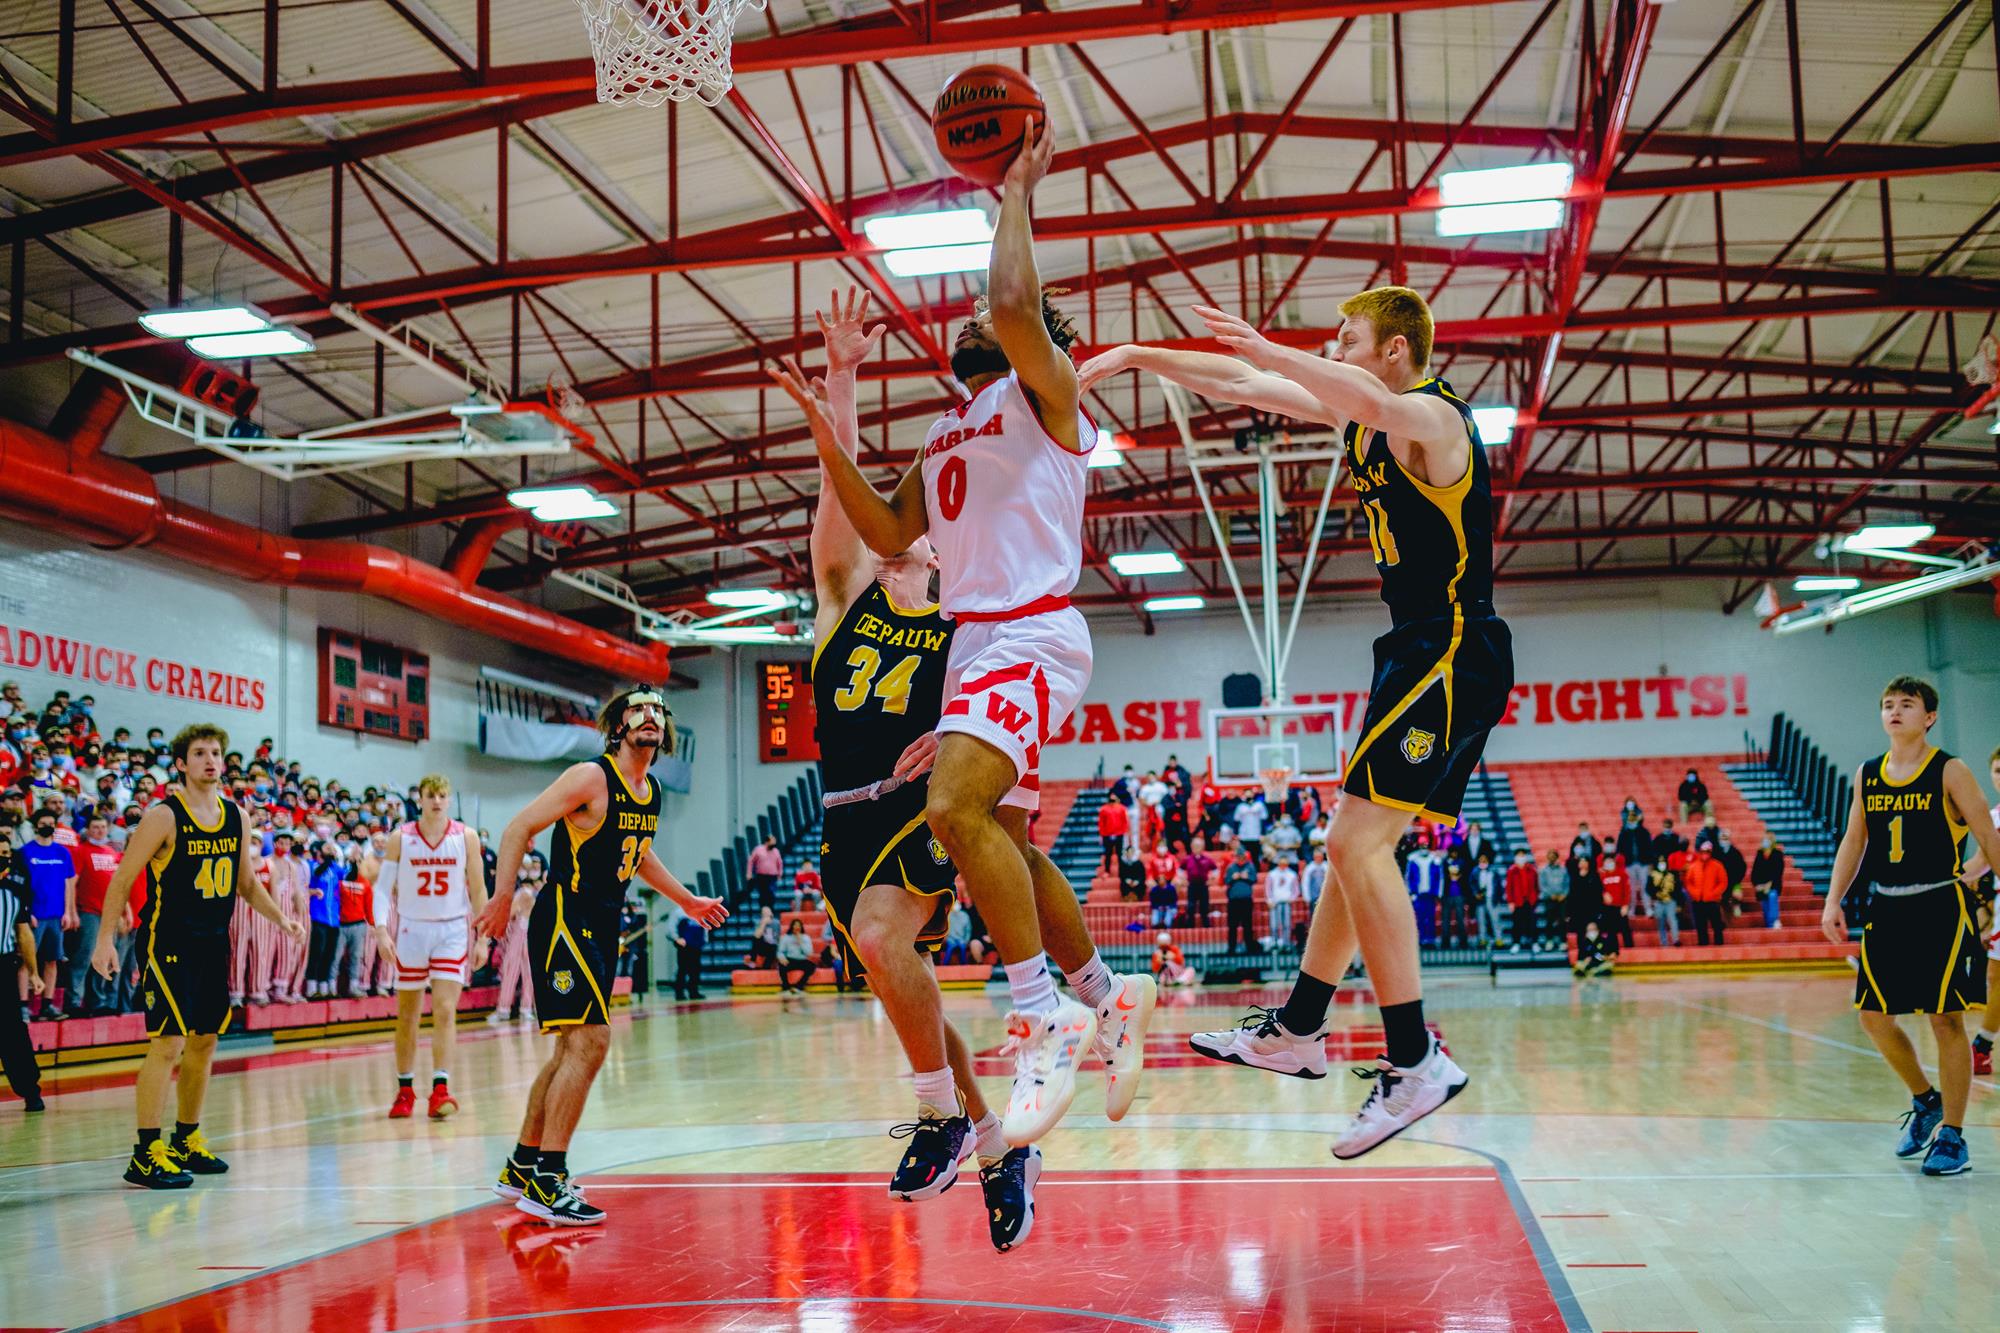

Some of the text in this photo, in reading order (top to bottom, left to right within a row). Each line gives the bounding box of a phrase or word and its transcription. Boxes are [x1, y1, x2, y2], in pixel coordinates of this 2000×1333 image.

[936, 84, 1007, 113] Wilson
[947, 117, 1001, 147] NCAA
[937, 455, 967, 521] 0
[0, 594, 26, 617] THE
[853, 613, 947, 651] DEPAUW
[145, 657, 265, 712] CRAZIES
[766, 675, 794, 700] 95
[834, 644, 922, 715] 34
[1498, 674, 1748, 726] FIGHTS!
[1866, 793, 1932, 812] DEPAUW
[187, 837, 238, 856] DEPAUW
[1888, 815, 1904, 863] 1
[194, 856, 233, 899] 40
[416, 871, 450, 897] 25
